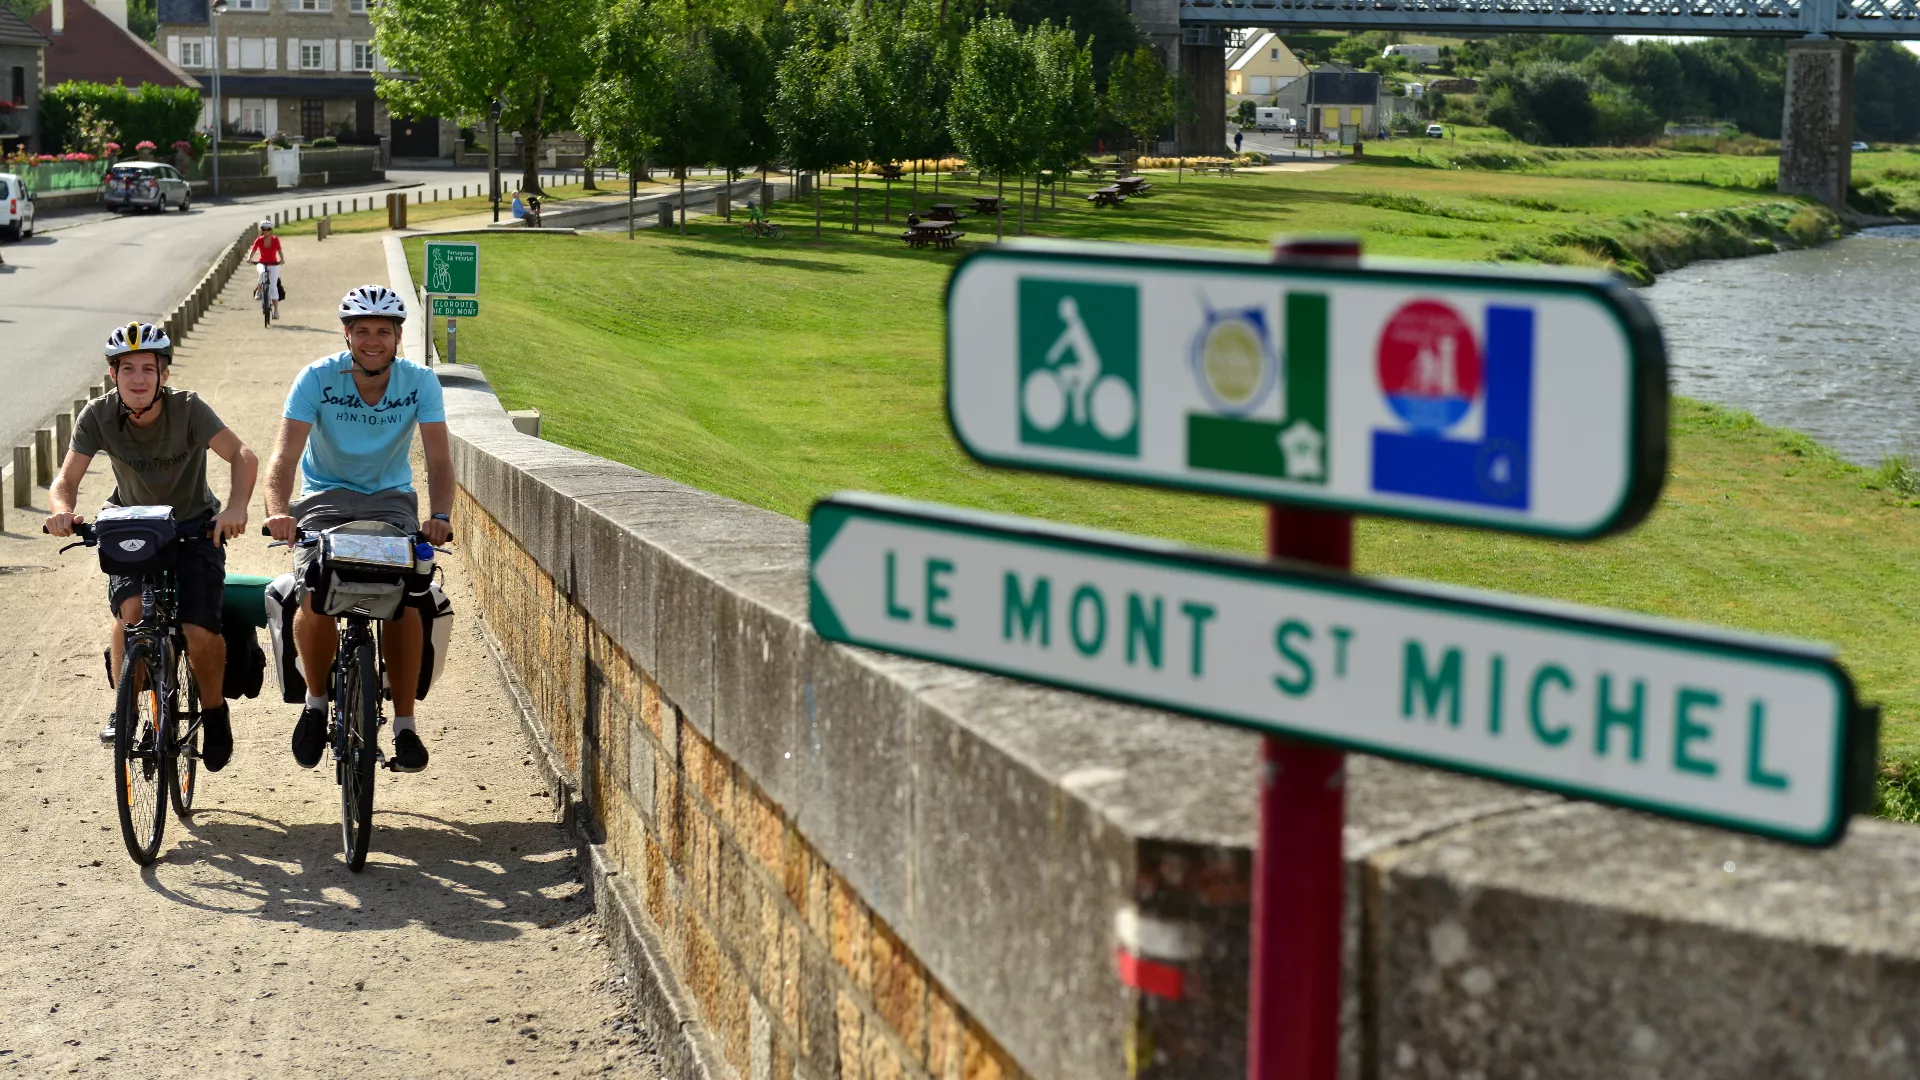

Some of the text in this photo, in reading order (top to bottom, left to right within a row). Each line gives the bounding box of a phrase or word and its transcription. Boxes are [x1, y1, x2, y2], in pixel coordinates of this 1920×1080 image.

[434, 300, 474, 308] ÉLOROUTE
[457, 308, 476, 316] MONT
[885, 549, 956, 630] LE
[1003, 570, 1216, 679] MONT
[1401, 638, 1791, 792] MICHEL
